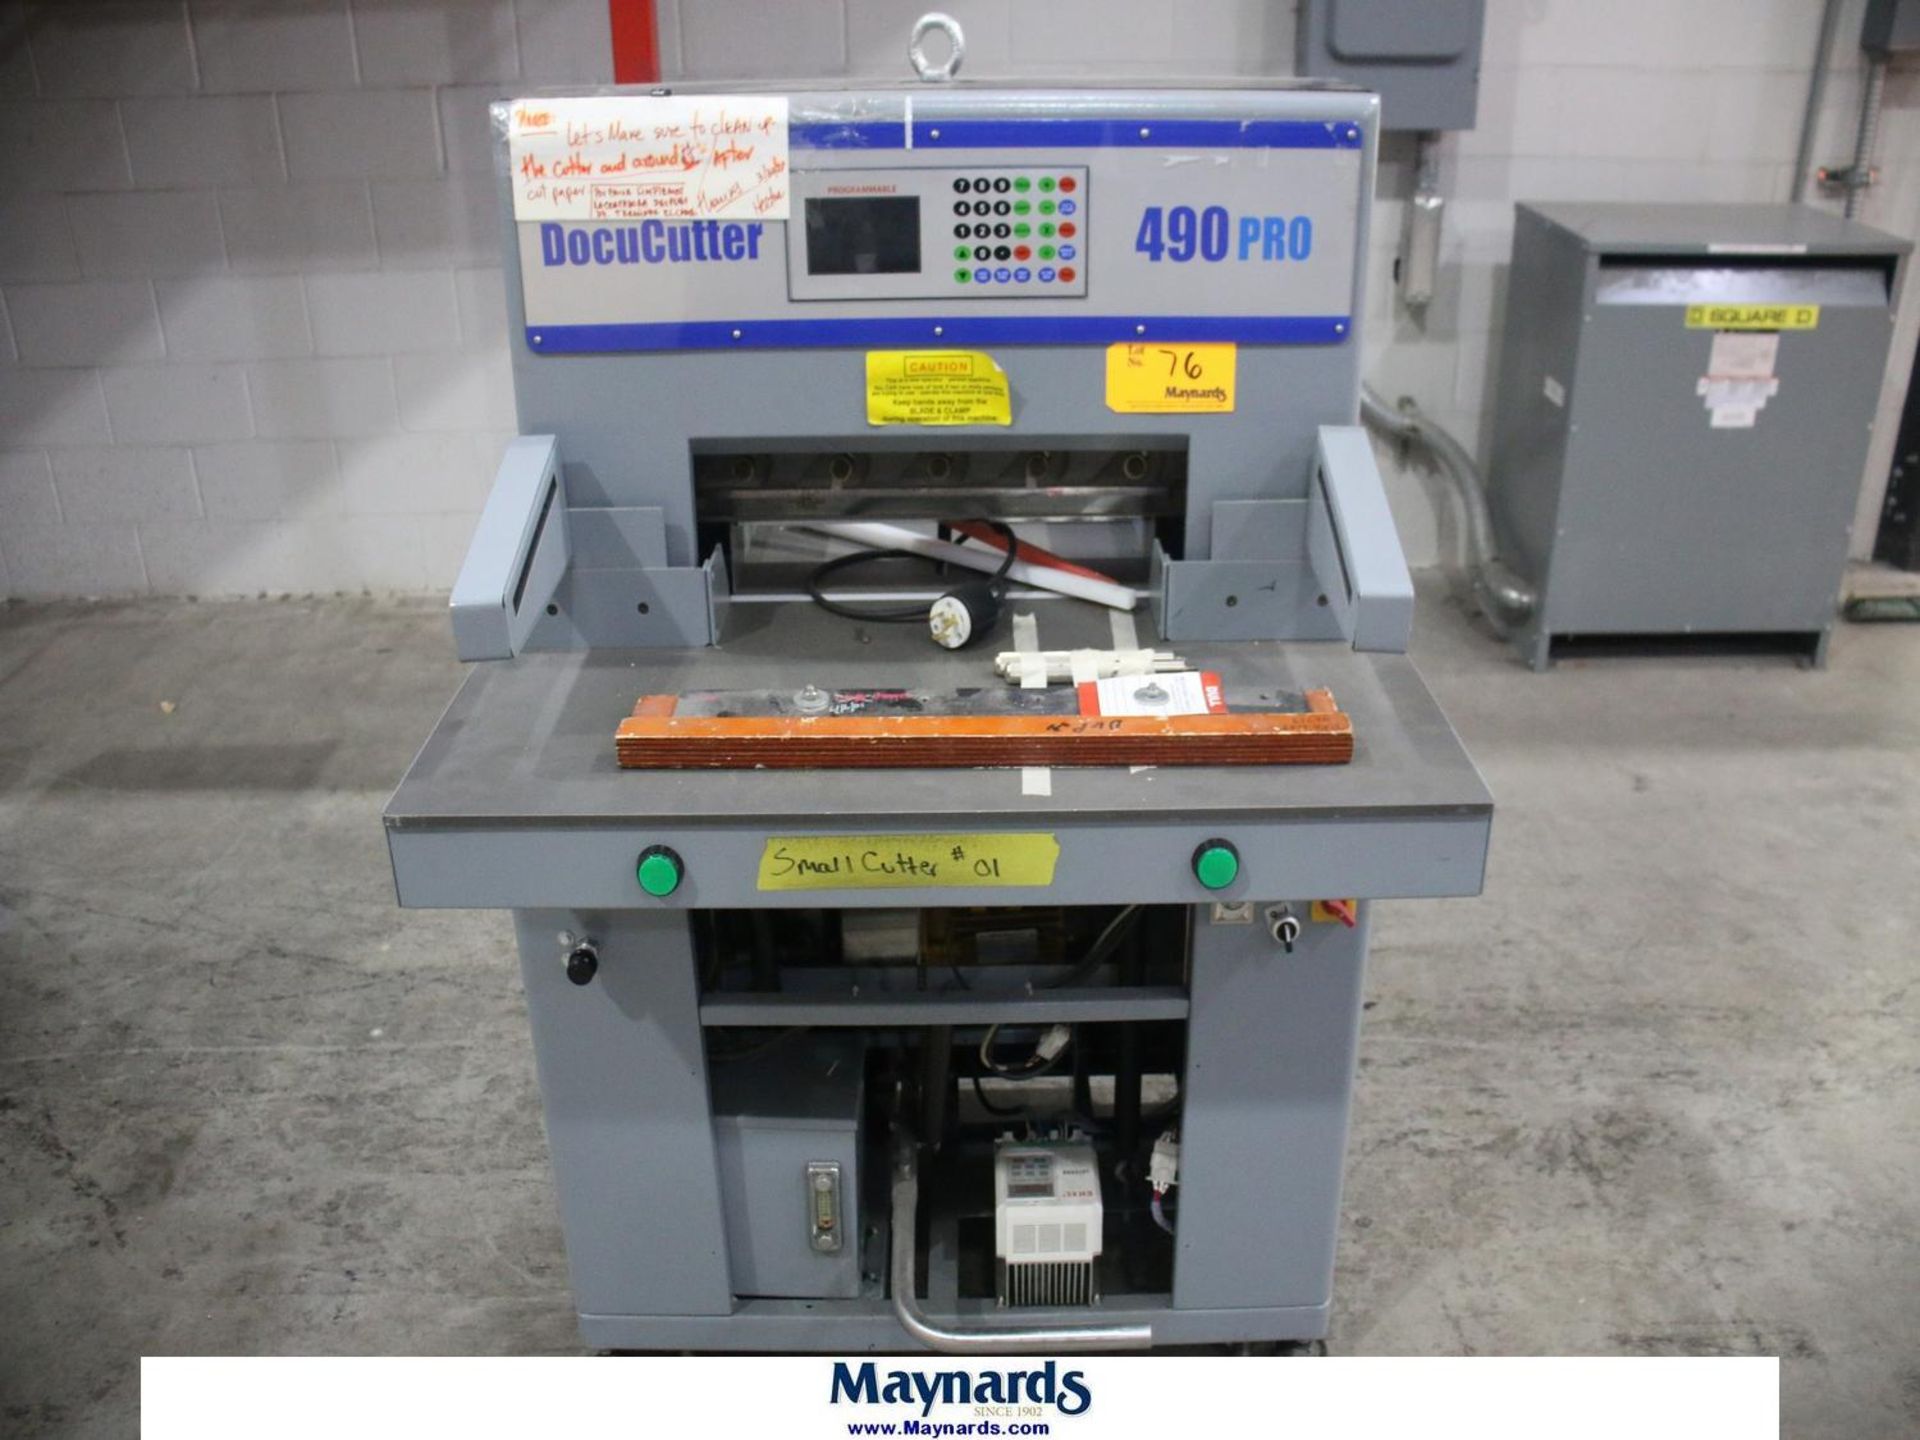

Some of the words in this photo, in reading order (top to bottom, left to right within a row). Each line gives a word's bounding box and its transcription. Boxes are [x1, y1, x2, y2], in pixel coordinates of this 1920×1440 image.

[690, 110, 706, 141] to
[601, 152, 625, 174] and
[827, 184, 897, 194] PROGRAMMABLE
[541, 218, 763, 267] DocuCutter
[1135, 205, 1229, 262] 490
[1238, 215, 1312, 261] PRO
[1710, 309, 1787, 323] SQUARE
[909, 361, 968, 373] CAUTION
[1159, 350, 1202, 379] 76
[1165, 386, 1227, 402] Maynards
[772, 848, 854, 876] Small
[862, 850, 937, 876] Cutter
[951, 845, 965, 861] #
